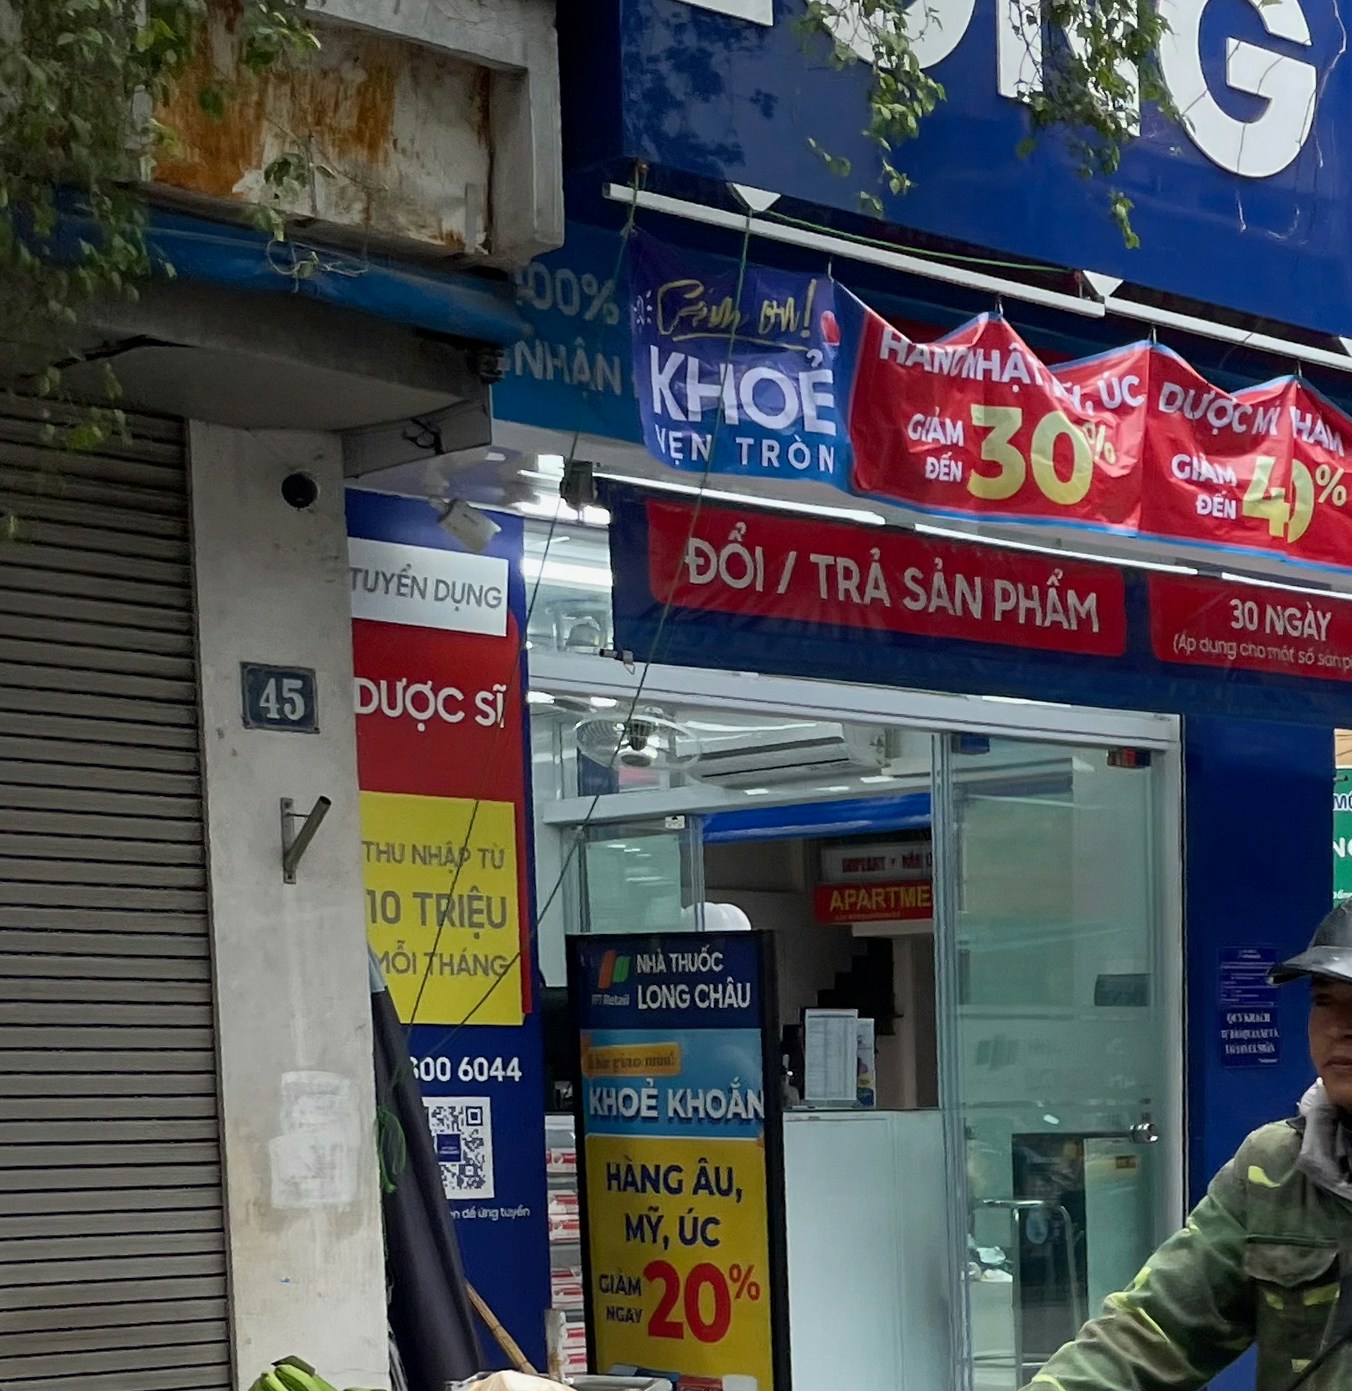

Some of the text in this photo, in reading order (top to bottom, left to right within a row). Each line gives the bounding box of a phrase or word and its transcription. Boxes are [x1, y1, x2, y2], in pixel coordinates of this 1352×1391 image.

[650, 344, 837, 437] KHOẺ
[654, 425, 834, 474] VẸN TRÒN
[907, 403, 1117, 505] GIẢM 30%
[925, 452, 963, 482] ĐẾN
[1196, 491, 1237, 519] ĐẾN
[350, 563, 503, 612] TUYỂN DỤNG
[684, 521, 1100, 633] ĐỔI / TRẢ SẢN PHẨM
[1230, 598, 1333, 642] 30 NGÀY
[259, 676, 306, 721] 45
[354, 676, 507, 732] DƯỢC SĨ
[361, 840, 506, 875] THU NHẬP TỪ
[366, 885, 508, 940] 10 TRIỆU
[423, 947, 510, 978] THÁNG
[636, 944, 724, 974] NHÀ THUỐC
[637, 976, 751, 1010] LONG CHÂU
[457, 1056, 523, 1083] 6044
[588, 1075, 766, 1120] KHOẺ KHOẮN
[605, 1155, 744, 1204] HÀNG ÂU,
[625, 1205, 721, 1251] MỸ, ÚC
[605, 1305, 644, 1324] NGAY
[643, 1259, 762, 1344] 20%
